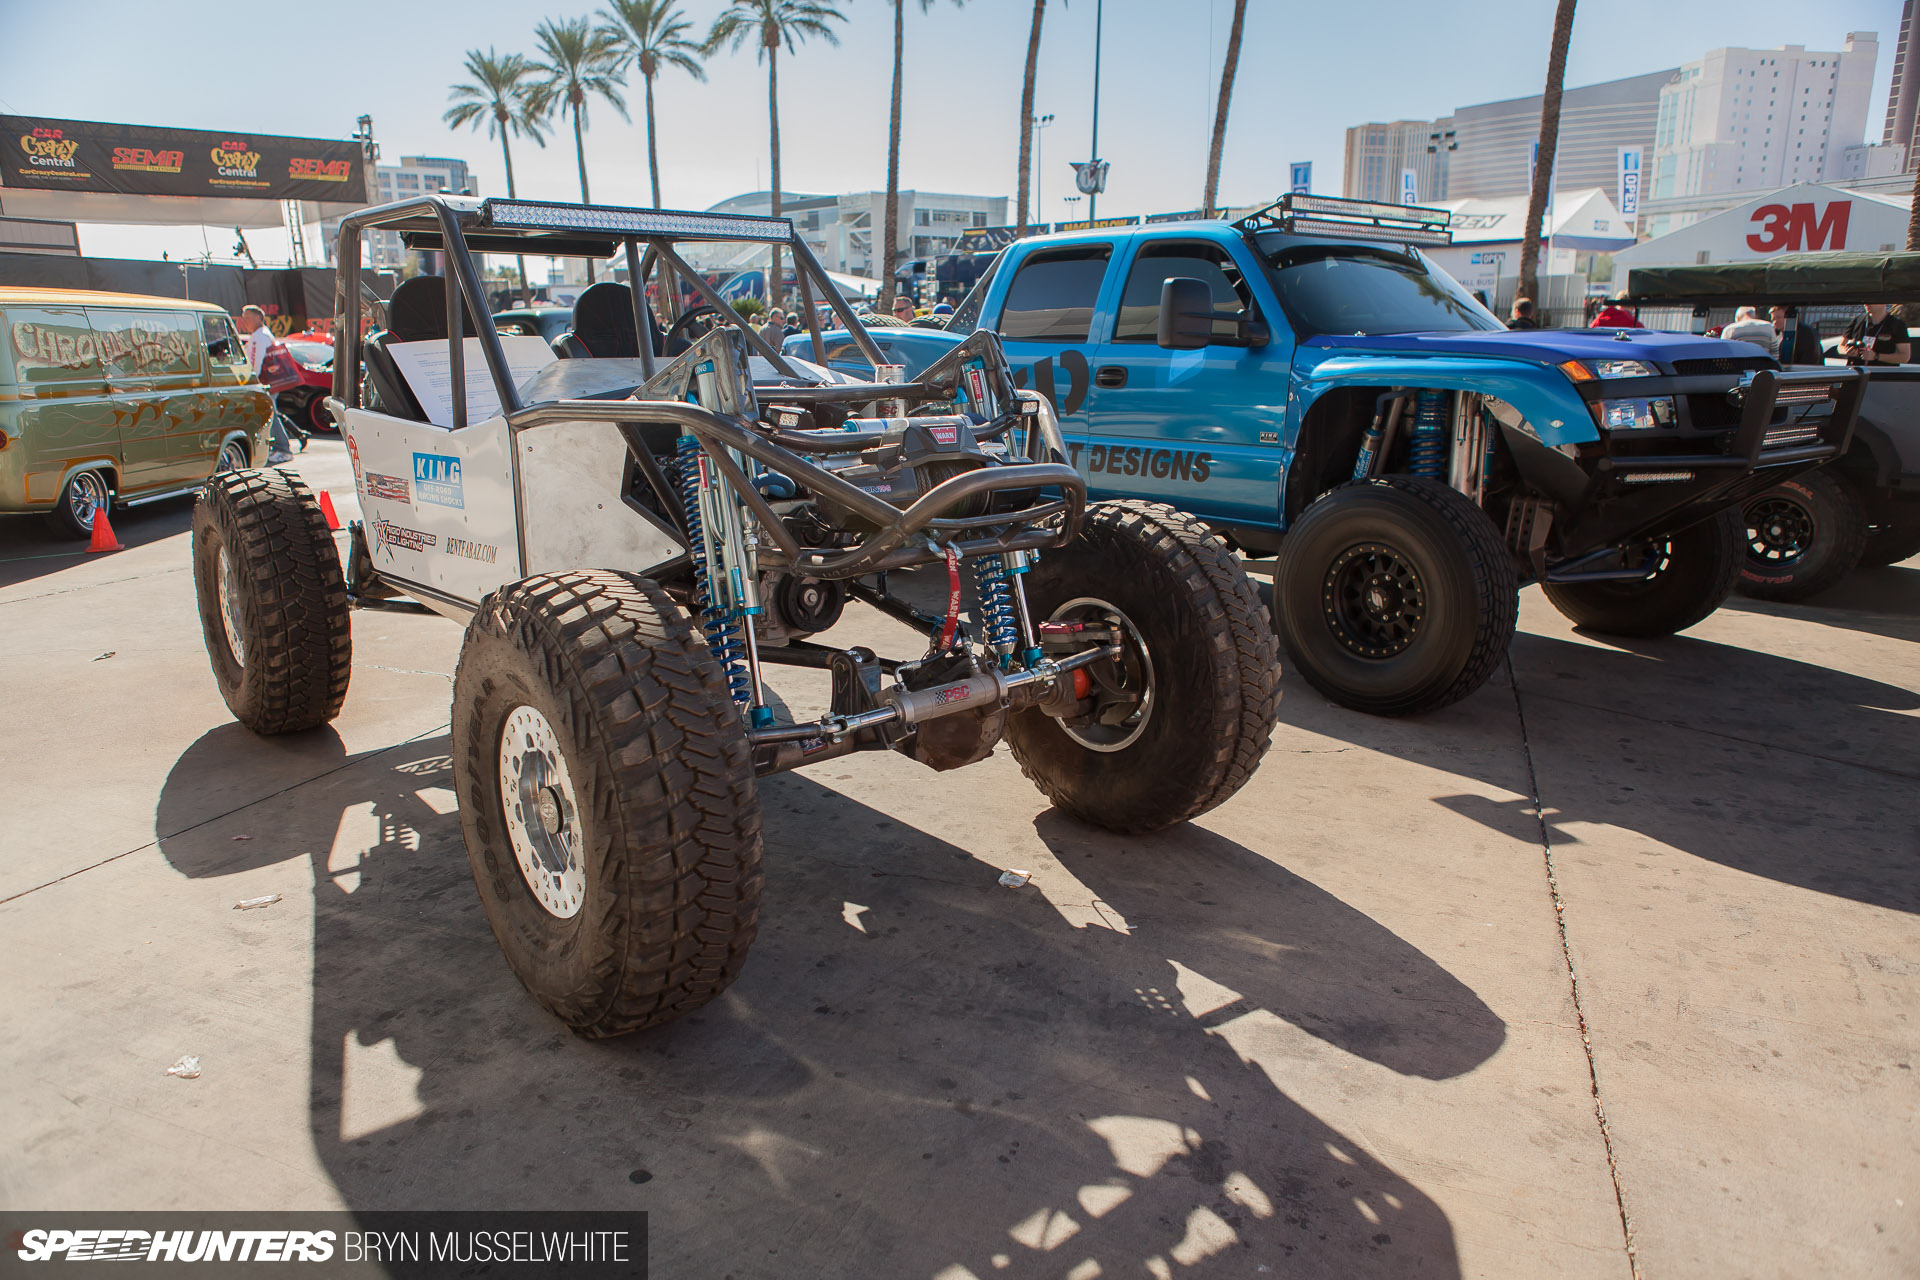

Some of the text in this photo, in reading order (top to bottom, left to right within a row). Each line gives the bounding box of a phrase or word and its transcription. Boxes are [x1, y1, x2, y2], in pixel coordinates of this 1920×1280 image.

[32, 128, 63, 140] CAR
[21, 135, 79, 161] Crazy
[221, 141, 248, 151] CAR
[29, 155, 76, 168] Central
[112, 147, 184, 167] SEMA
[210, 147, 261, 171] Crazy
[218, 166, 257, 178] Central
[288, 158, 350, 177] SEMA
[1624, 174, 1638, 213] OPEN
[1450, 213, 1506, 230] PEN
[1746, 200, 1852, 253] 3M
[13, 321, 132, 370] CHROME
[935, 432, 955, 440] WARN
[416, 457, 460, 484] KING
[1089, 444, 1212, 483] DESIGNS
[440, 495, 463, 507] SHOCKS
[397, 536, 424, 552] LIGHTING
[400, 527, 437, 545] INDUSTRIES
[949, 591, 960, 618] WARN
[945, 684, 971, 702] PSC
